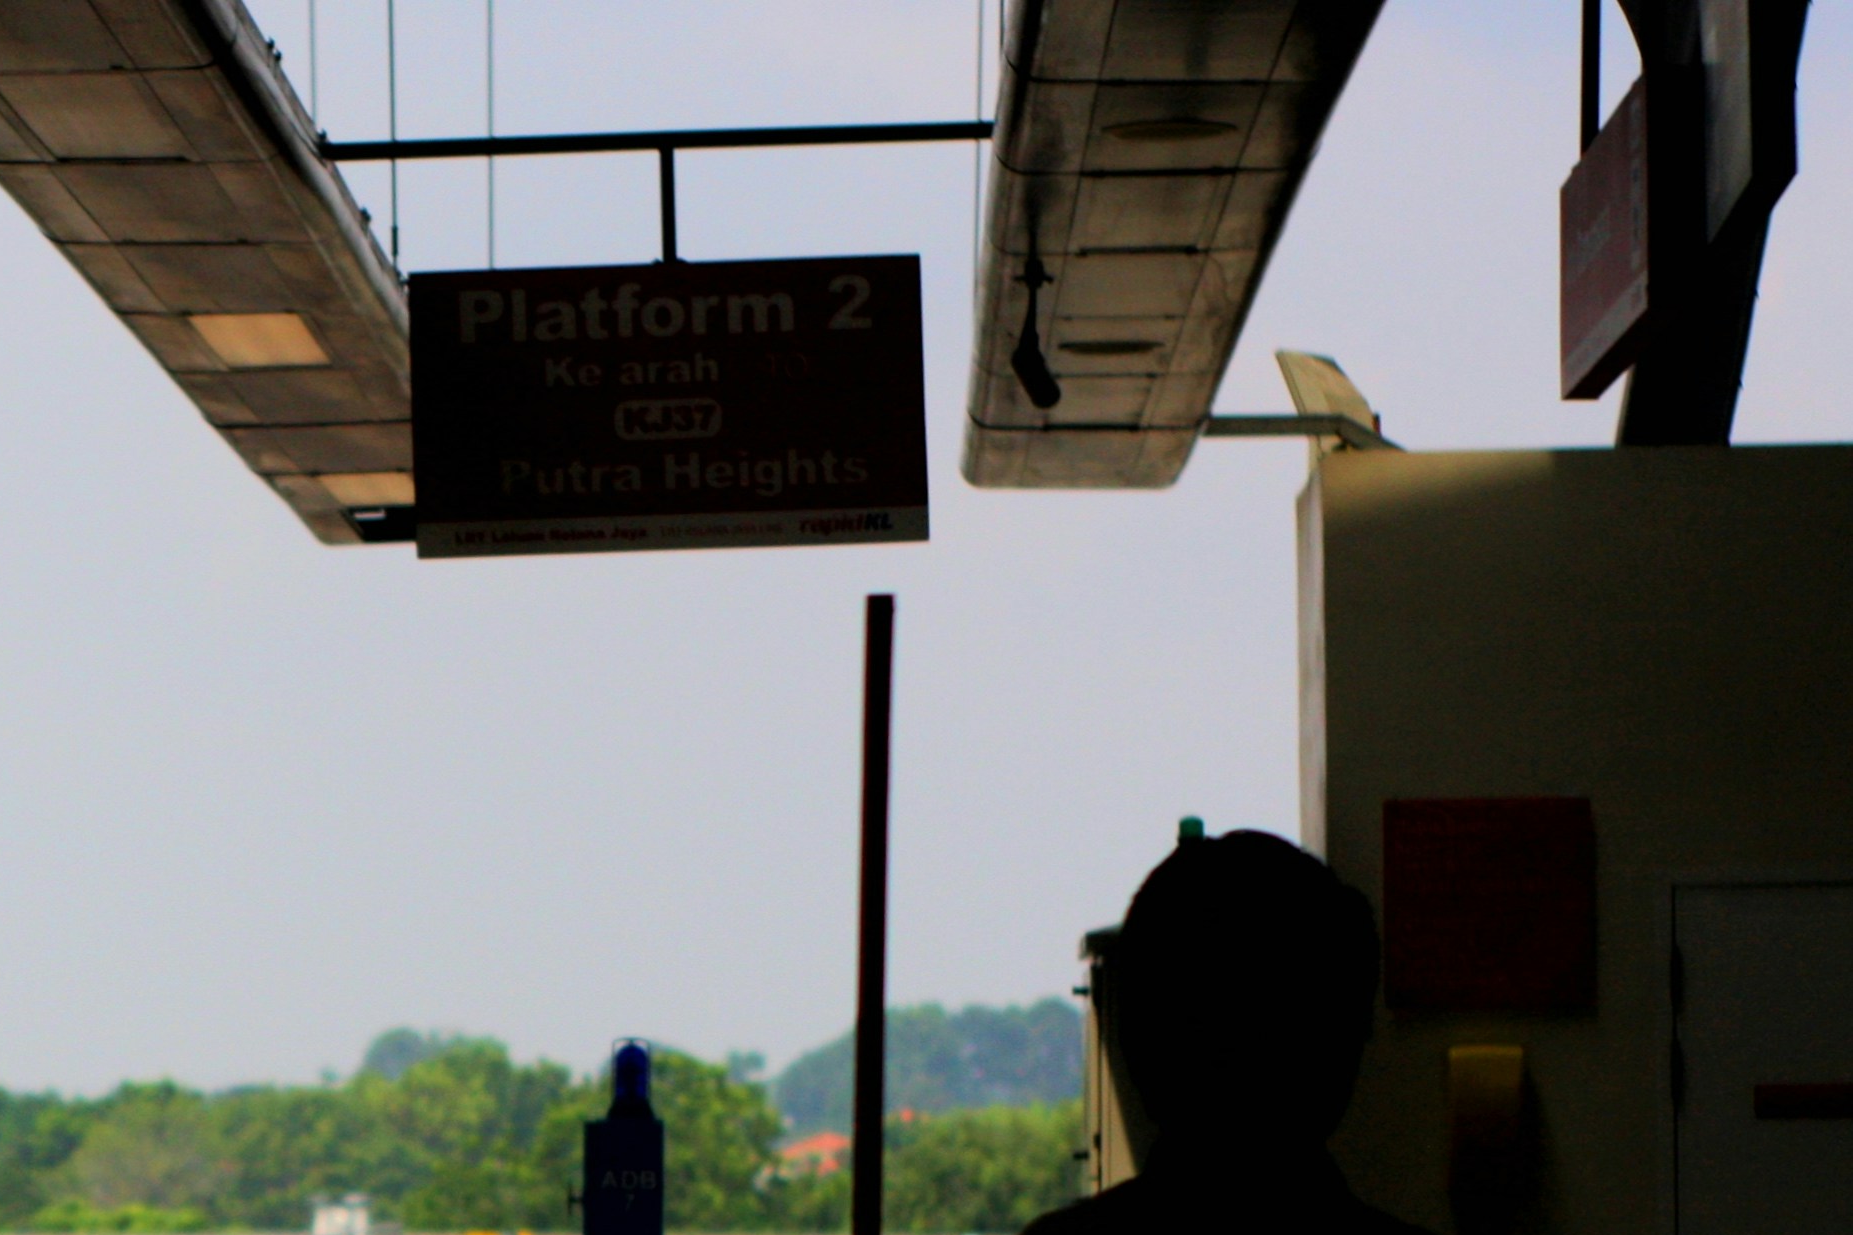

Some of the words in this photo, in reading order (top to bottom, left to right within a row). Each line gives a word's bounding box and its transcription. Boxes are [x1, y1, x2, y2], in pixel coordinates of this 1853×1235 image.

[457, 282, 795, 343] Platform
[827, 274, 873, 330] 2
[544, 356, 602, 387] Ke
[619, 352, 718, 385] arah
[622, 405, 715, 434] KJ37
[499, 458, 642, 495] Putra
[663, 448, 869, 497] Heights
[600, 1169, 658, 1190] ADB
